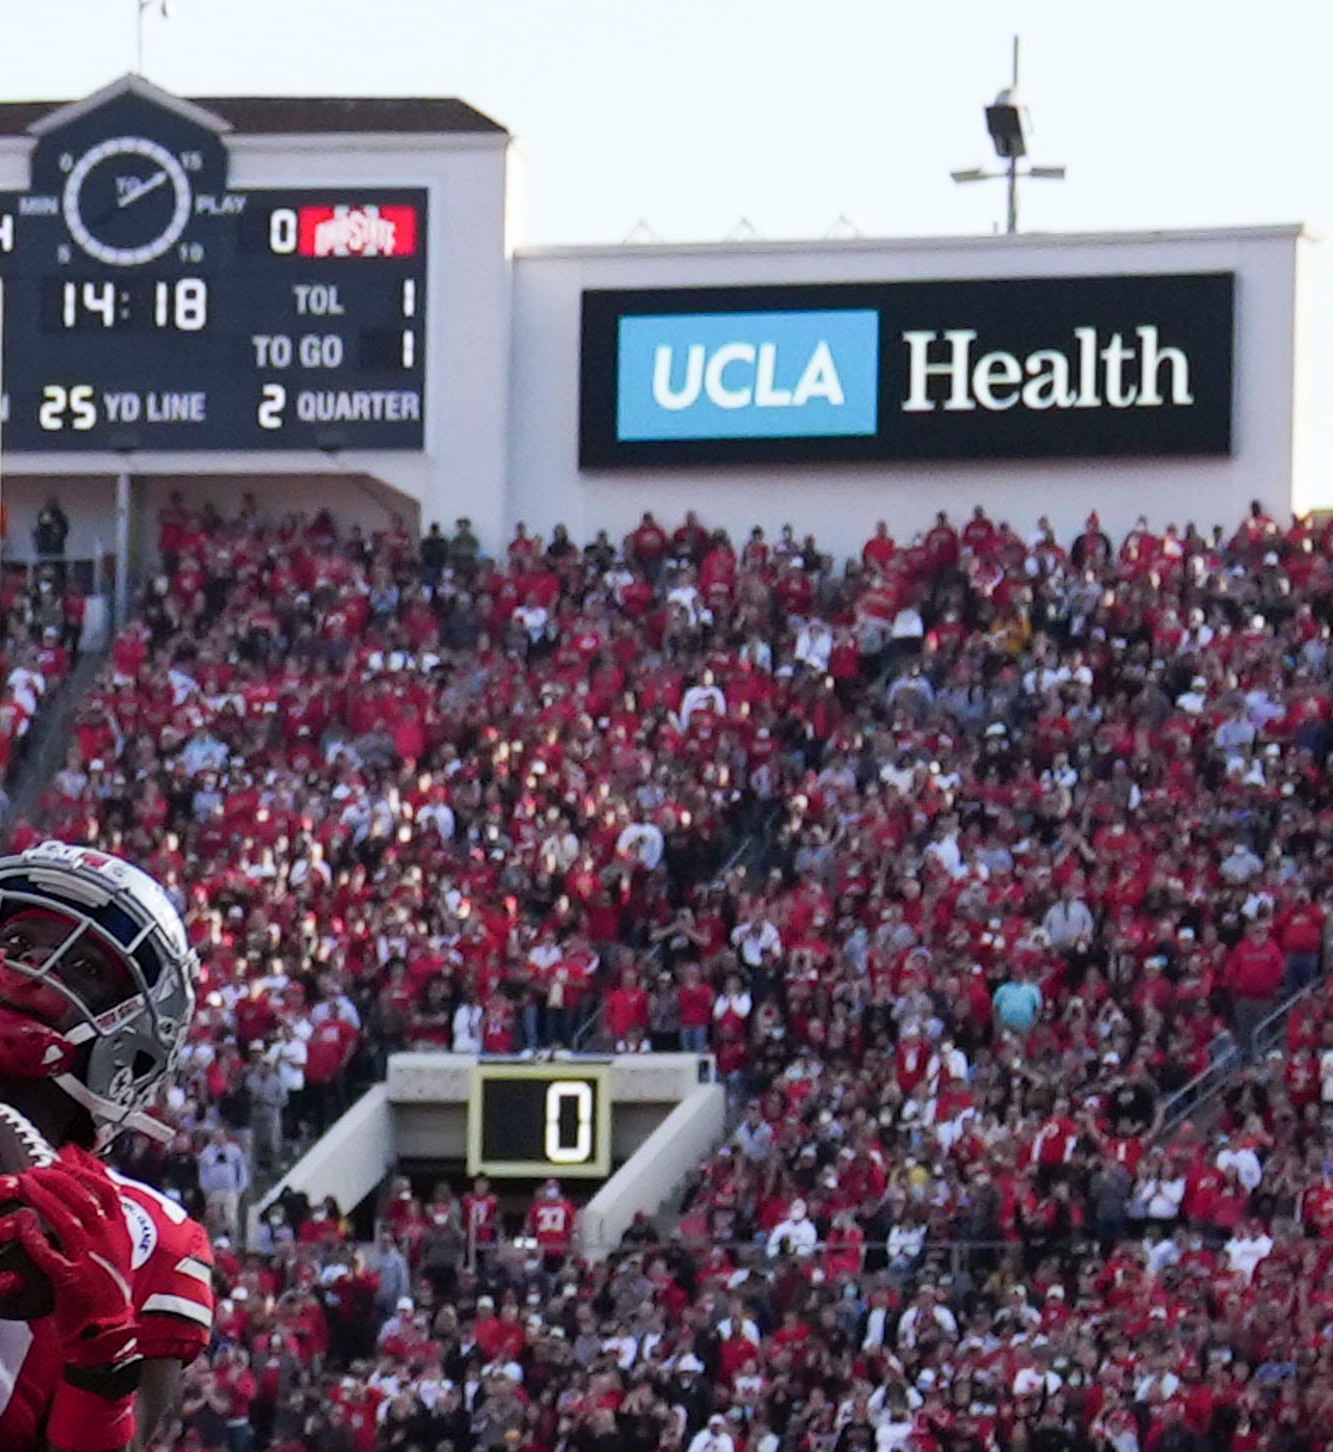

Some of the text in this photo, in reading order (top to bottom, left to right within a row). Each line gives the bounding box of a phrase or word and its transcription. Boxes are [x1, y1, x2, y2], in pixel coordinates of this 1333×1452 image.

[194, 194, 247, 214] PLAY
[270, 208, 297, 254] 0
[293, 278, 415, 318] TOL 1
[252, 329, 415, 369] TO GO 1
[902, 325, 1193, 412] Health
[651, 340, 844, 411] UCLA
[39, 385, 97, 431] 25
[103, 391, 141, 422] YD
[146, 391, 206, 422] LINE
[258, 383, 420, 429] 2 QUARTER
[545, 1081, 592, 1163] 0
